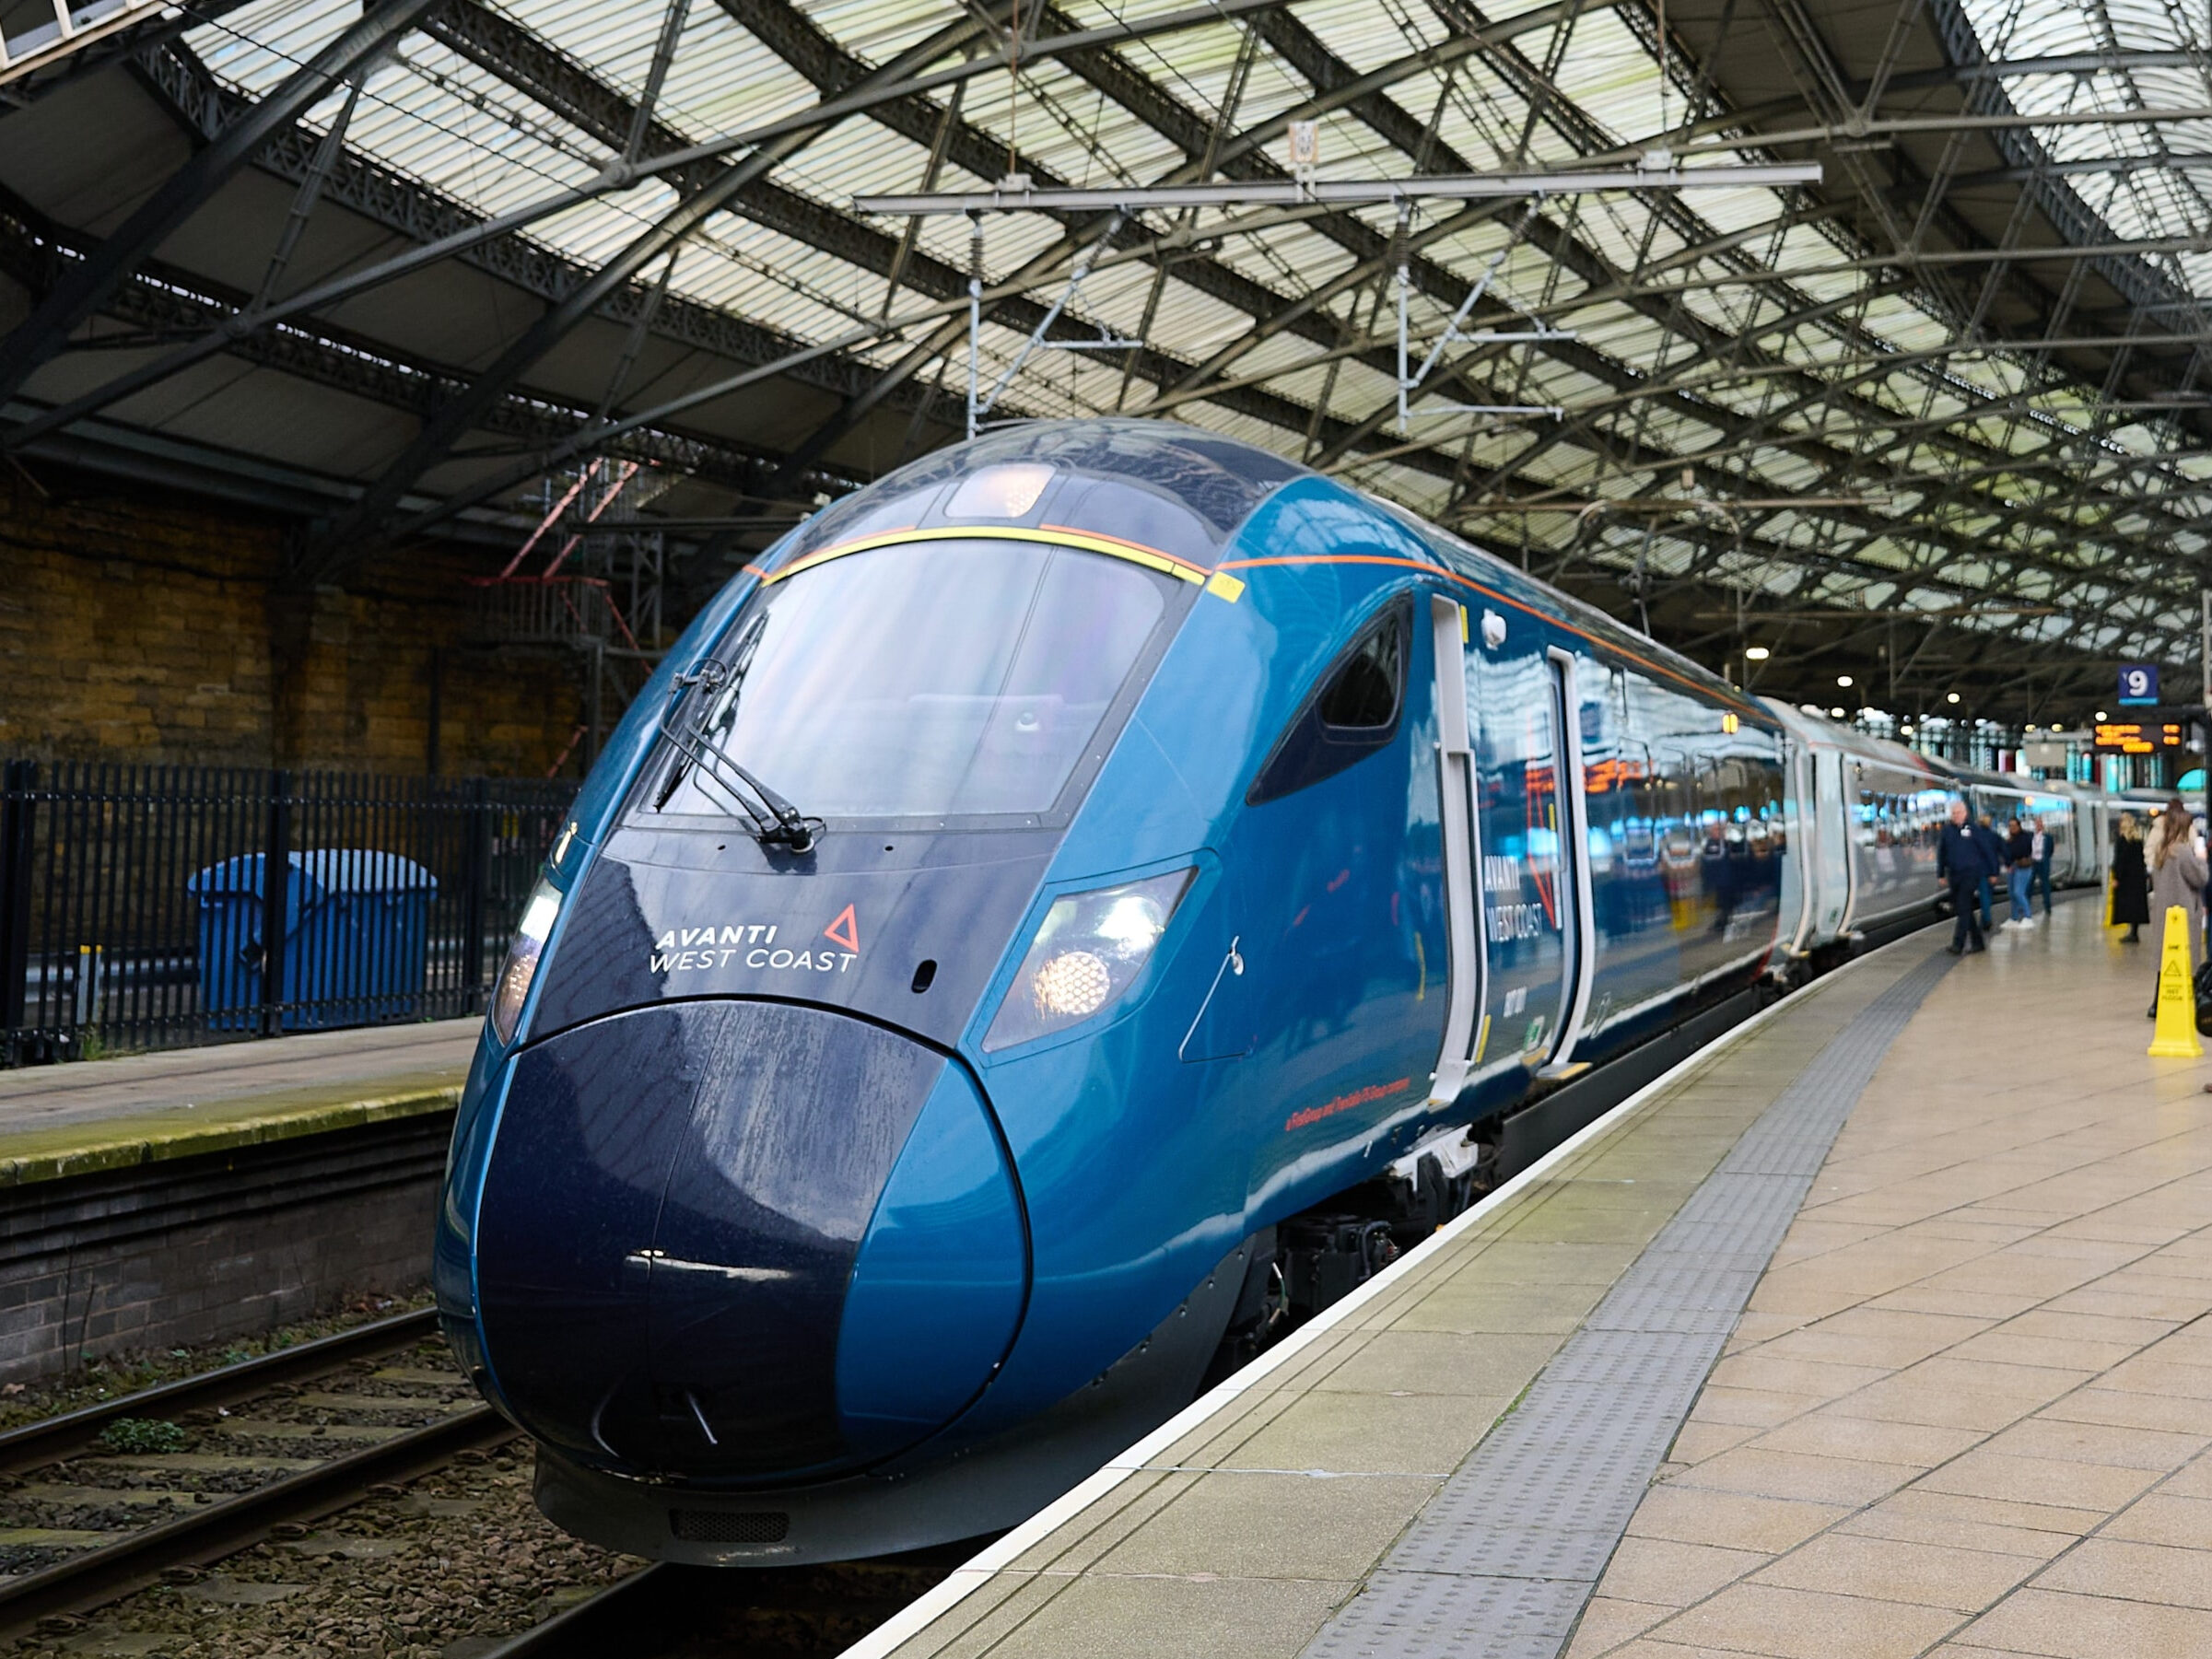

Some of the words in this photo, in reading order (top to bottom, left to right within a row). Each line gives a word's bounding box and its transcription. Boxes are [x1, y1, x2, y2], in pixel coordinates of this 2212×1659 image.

[2127, 670, 2148, 696] 9
[655, 925, 778, 951] AVANTI
[650, 949, 737, 974] WEST
[745, 948, 858, 974] COAST
